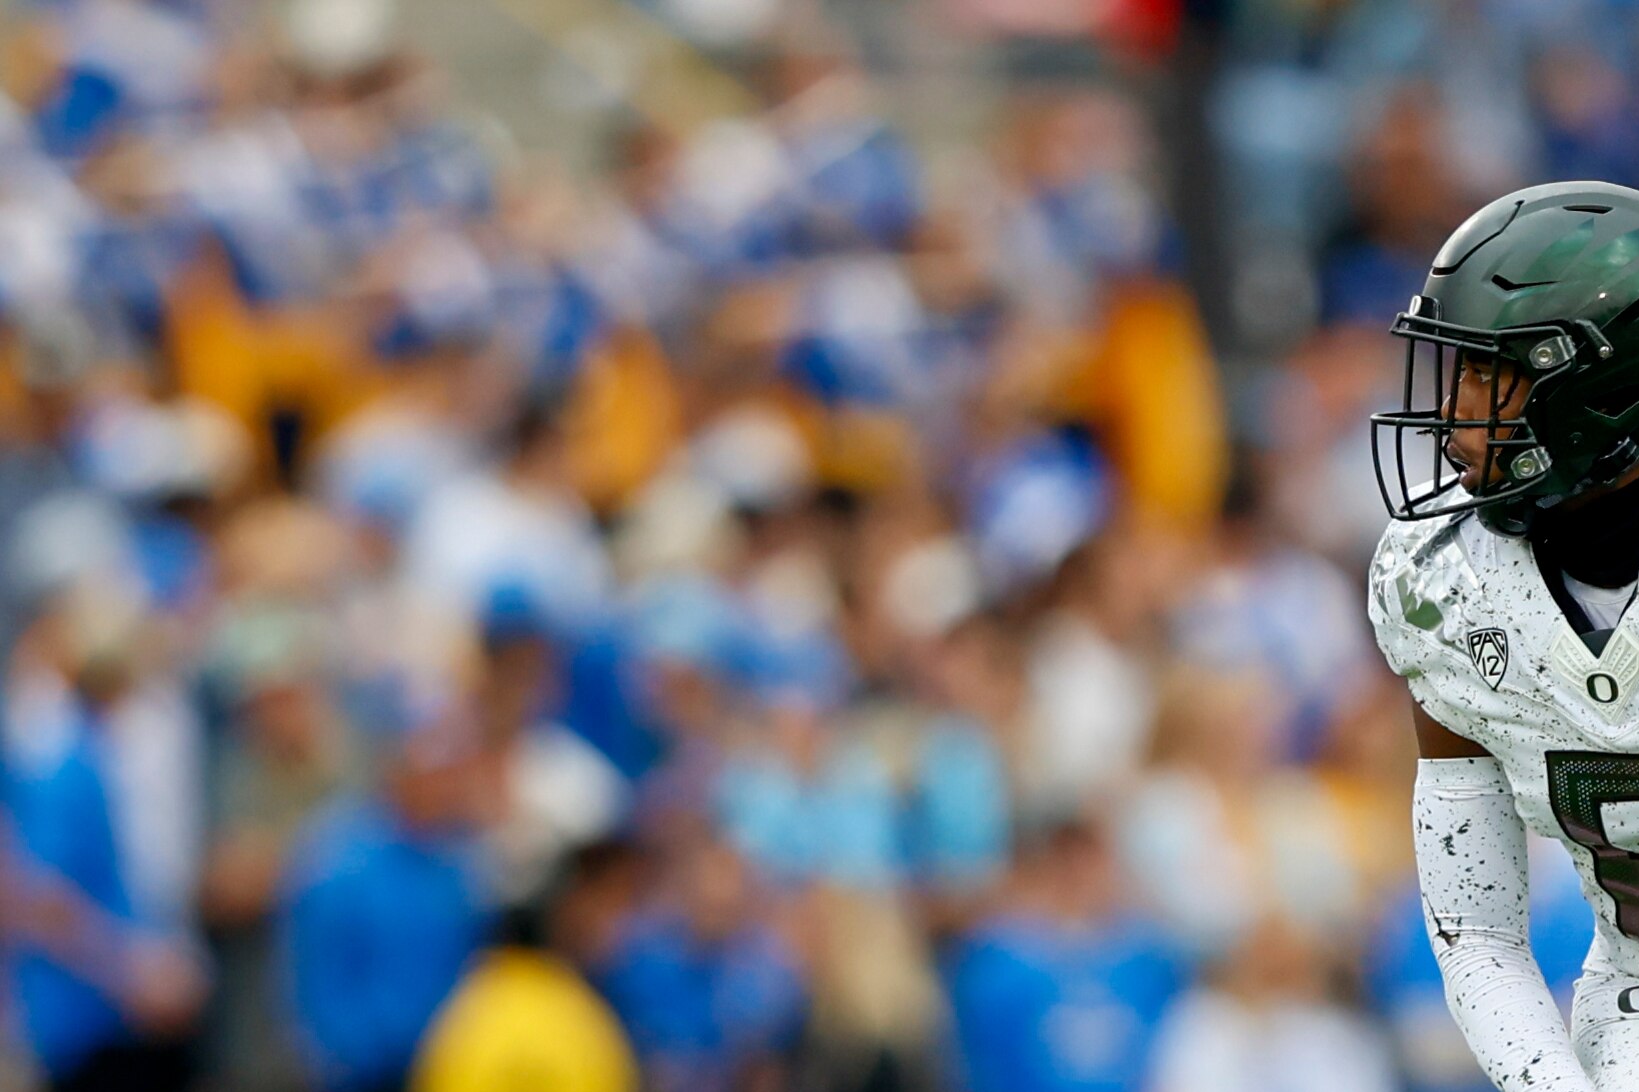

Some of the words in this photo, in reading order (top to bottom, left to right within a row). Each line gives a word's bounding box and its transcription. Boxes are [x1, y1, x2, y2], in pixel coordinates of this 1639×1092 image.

[1470, 632, 1505, 666] PAC
[1482, 656, 1501, 677] 12
[1586, 673, 1619, 703] O
